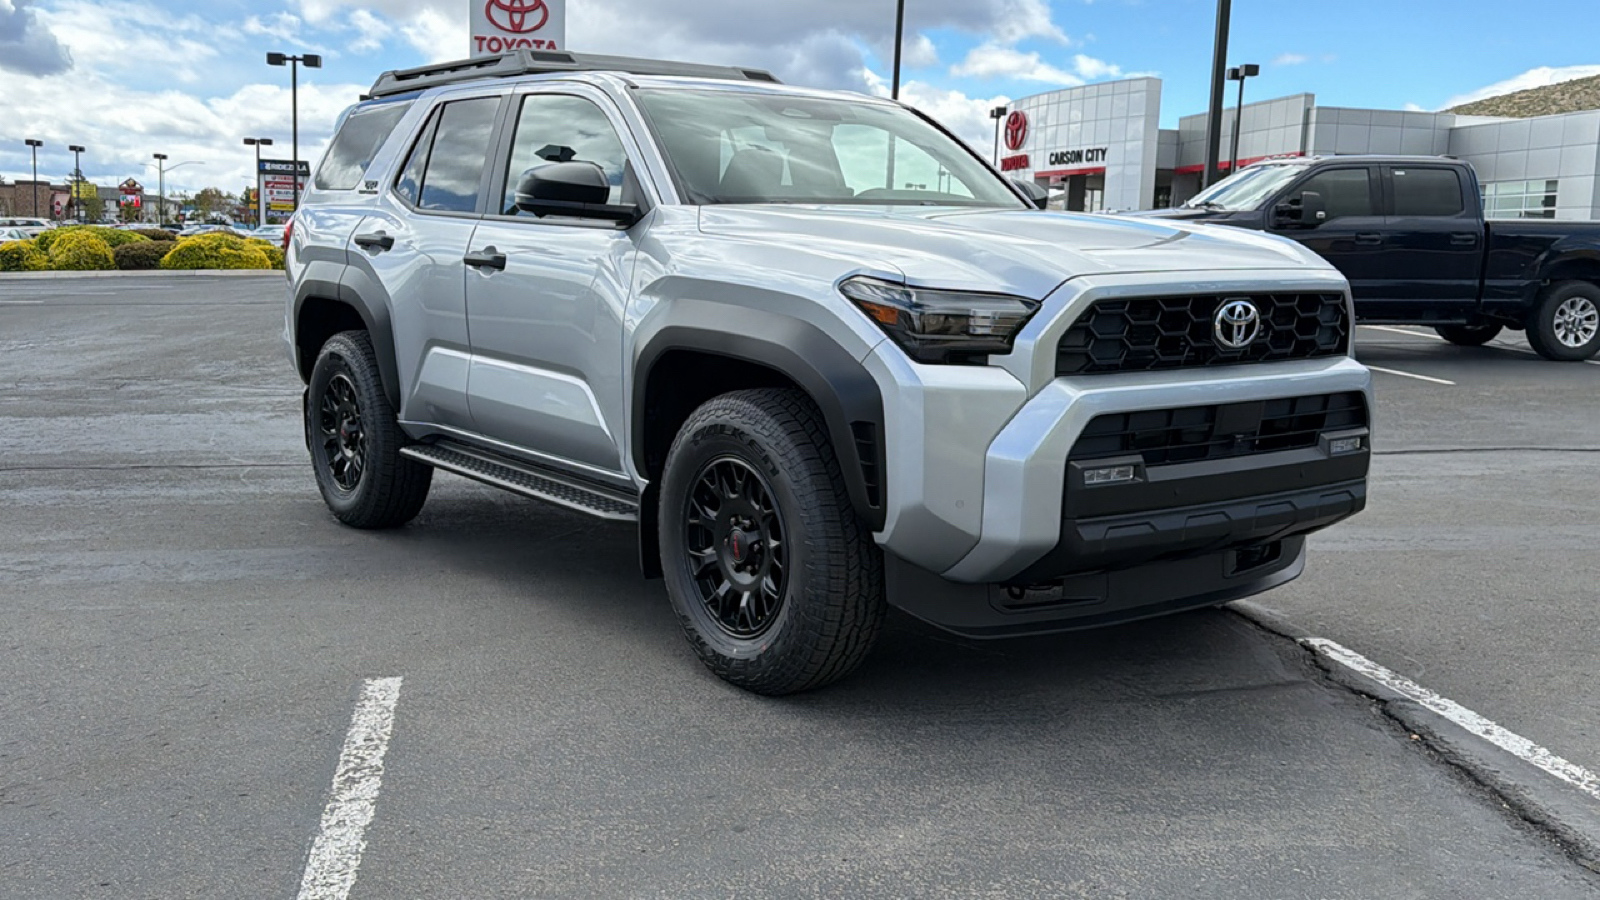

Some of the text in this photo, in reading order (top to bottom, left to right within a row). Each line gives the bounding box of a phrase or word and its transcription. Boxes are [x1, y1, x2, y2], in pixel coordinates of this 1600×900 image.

[474, 36, 557, 53] TOYOTA
[1001, 154, 1029, 171] TOYOTA
[1049, 147, 1108, 166] CARSON CITY
[271, 163, 307, 171] RIDEZLA
